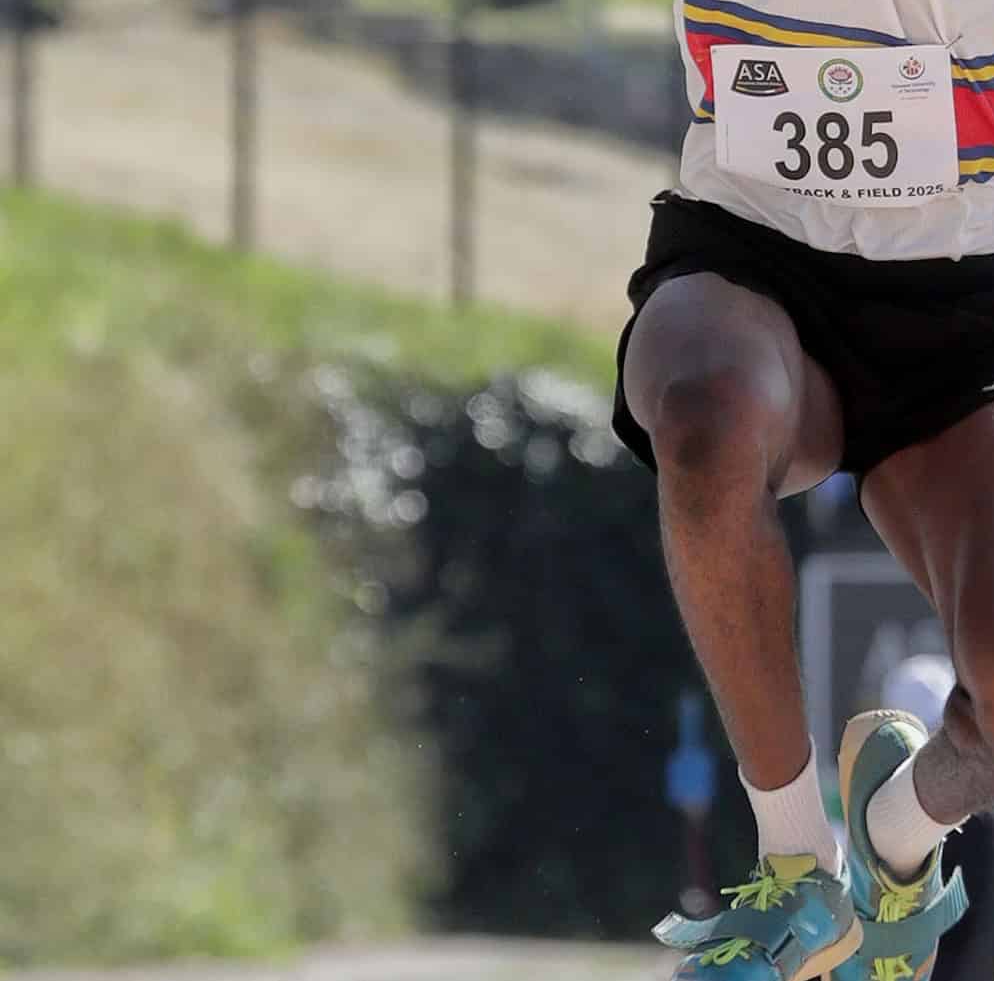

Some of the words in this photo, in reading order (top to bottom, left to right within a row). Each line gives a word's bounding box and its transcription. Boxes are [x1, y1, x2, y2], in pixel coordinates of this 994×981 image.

[738, 63, 781, 81] ASA
[773, 111, 898, 180] 385
[783, 187, 835, 198] RACK
[841, 188, 852, 199] &
[858, 187, 901, 198] FIELD
[907, 184, 944, 196] 2025
